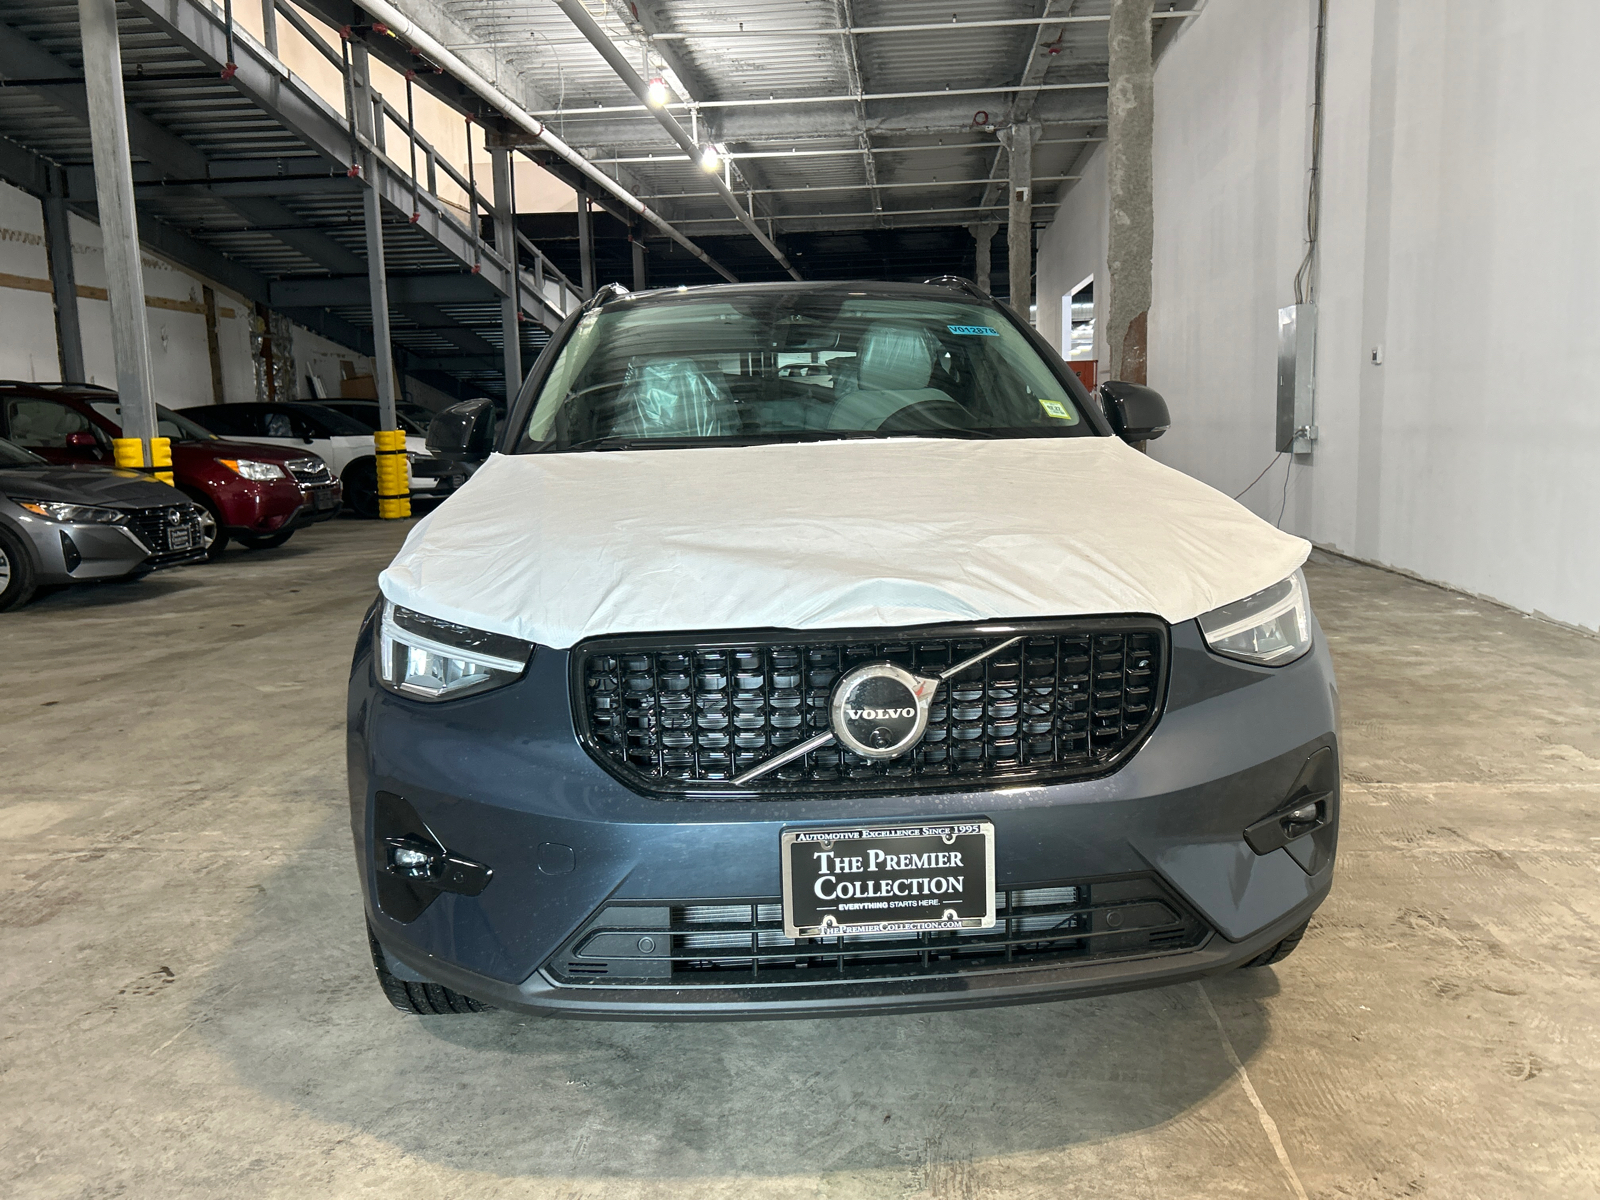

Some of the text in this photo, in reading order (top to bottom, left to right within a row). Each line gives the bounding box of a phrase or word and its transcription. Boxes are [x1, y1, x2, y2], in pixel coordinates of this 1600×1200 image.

[846, 707, 915, 720] VOLVO
[953, 825, 979, 834] 1995
[839, 899, 940, 911] EVERYTHING STARTS HERE.
